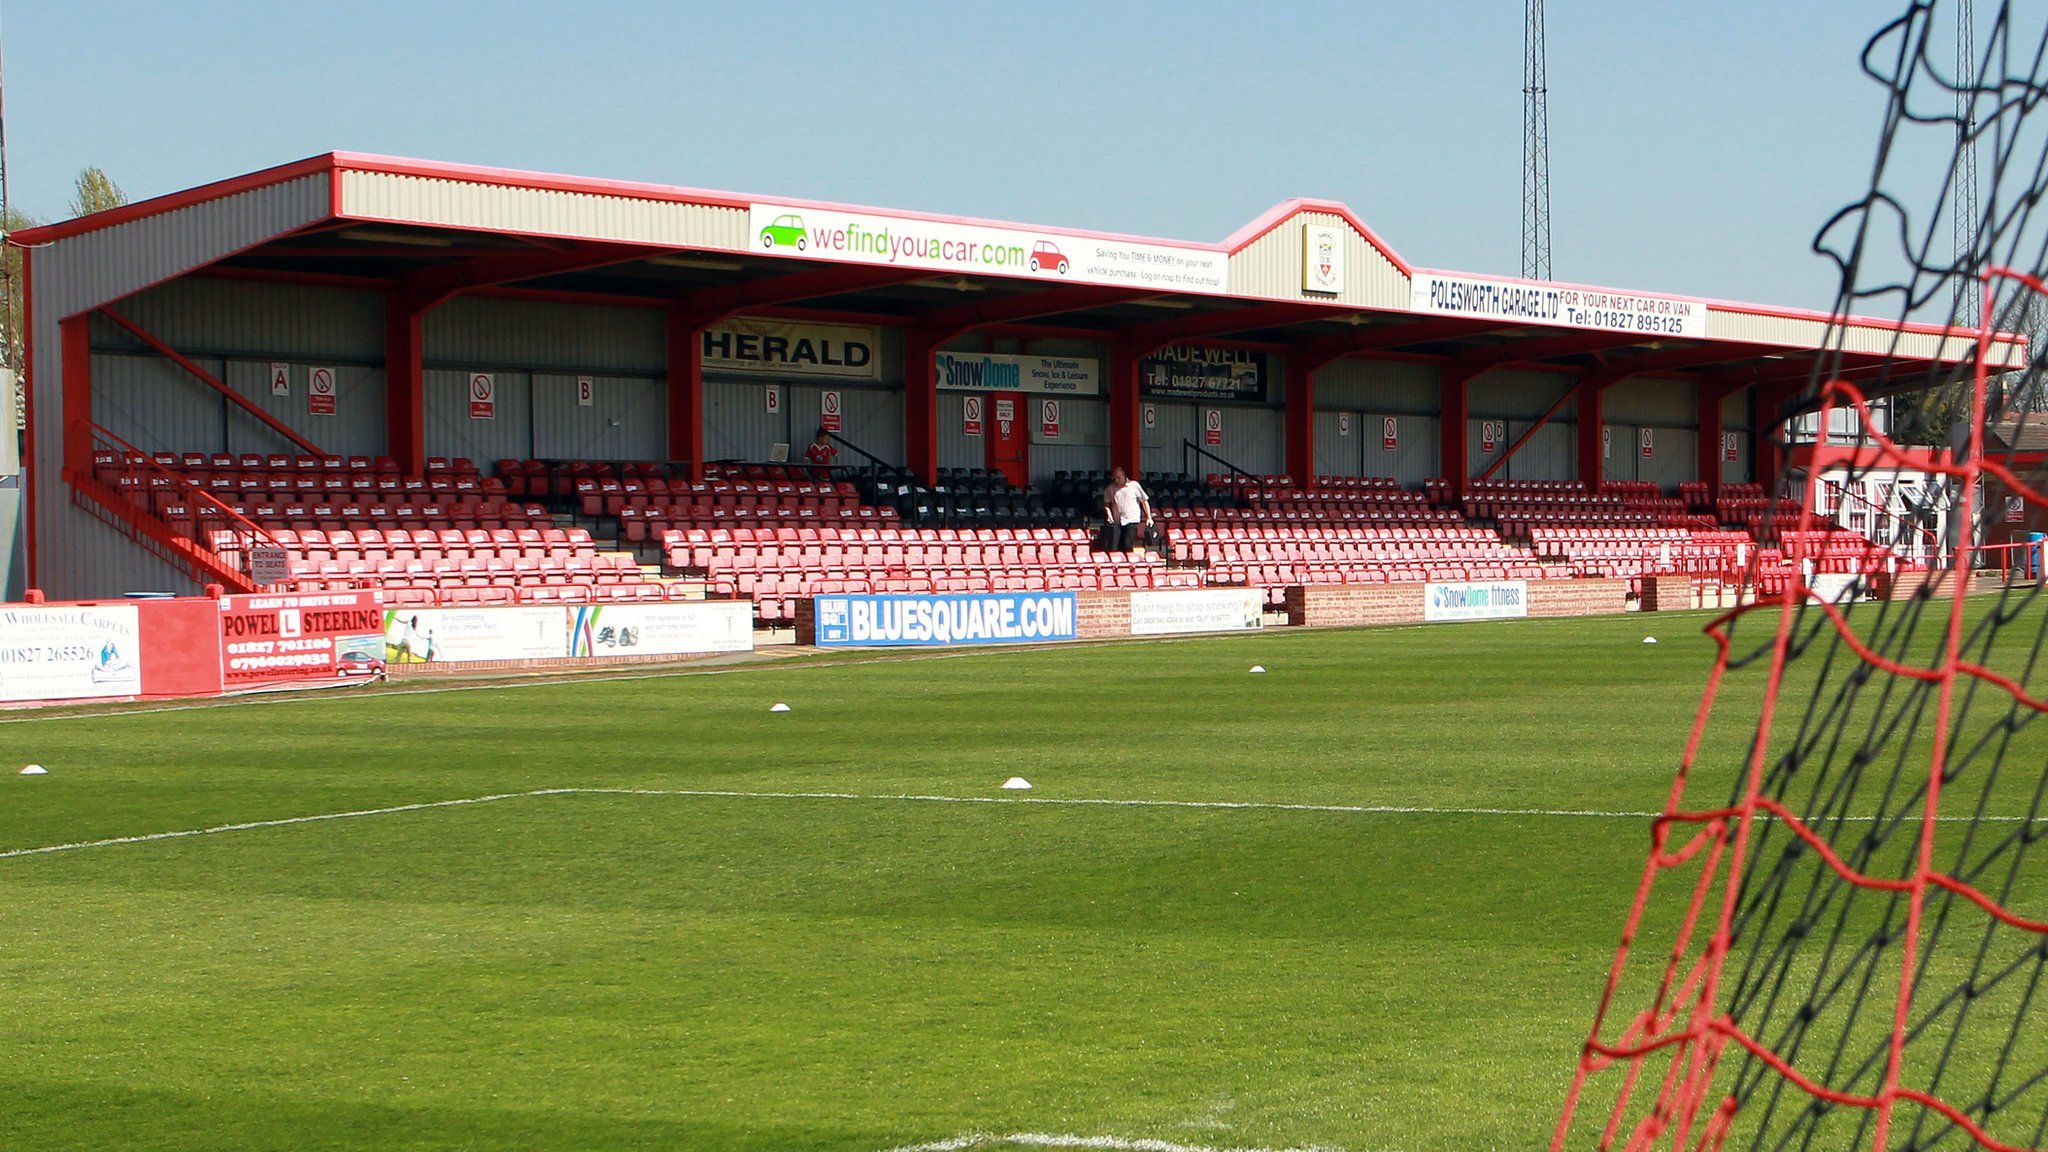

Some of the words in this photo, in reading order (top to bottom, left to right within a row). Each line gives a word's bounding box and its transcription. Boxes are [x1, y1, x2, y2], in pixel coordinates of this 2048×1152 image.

[813, 223, 1025, 267] wefindyouacar.com
[1096, 248, 1117, 261] Saving
[1131, 252, 1145, 262] TIME
[1153, 254, 1176, 265] MONEY
[1087, 265, 1108, 275] vehicle
[1110, 269, 1136, 279] purchase
[1141, 270, 1152, 281] Log
[1175, 274, 1182, 282] to
[1430, 279, 1499, 315] POLESWORTH
[1501, 286, 1539, 318] GARAGE
[1541, 290, 1559, 320] LTD
[1560, 291, 1579, 306] FOR
[1583, 293, 1608, 309] YOUR
[1609, 295, 1635, 311] NEXT
[1636, 298, 1656, 313] CAR
[1657, 300, 1671, 314] OR
[1672, 302, 1691, 316] VAN
[1567, 307, 1591, 325] Tel:
[1594, 309, 1633, 329] 01827
[1636, 314, 1683, 334] 895125
[703, 330, 871, 367] HERALD
[946, 354, 1020, 388] SnowDome
[1041, 359, 1052, 368] The
[1053, 360, 1079, 369] Ultimate
[274, 369, 288, 389] A
[1051, 371, 1060, 379] Ice
[1061, 371, 1067, 379] &
[1067, 371, 1088, 381] Leisure
[1147, 373, 1169, 386] Tel:
[1172, 375, 1206, 388] 01827
[1208, 377, 1241, 390] 67721
[581, 382, 590, 400] B
[1044, 380, 1077, 391] Experience
[768, 391, 777, 408] B
[1146, 409, 1154, 424] C
[1340, 418, 1348, 431] C
[253, 551, 287, 559] ENTRANCE
[254, 560, 263, 568] TO
[265, 560, 285, 568] SEATS
[248, 597, 283, 609] LEARN
[284, 596, 299, 608] TO
[299, 595, 330, 607] DRIVE
[330, 594, 357, 606] WITH
[1443, 585, 1489, 608] SnowDome
[1491, 584, 1520, 606] fitness
[1133, 603, 1153, 614] Want
[1157, 602, 1174, 614] help
[1176, 602, 1185, 612] to
[1187, 601, 1204, 613] stop
[1207, 599, 1243, 613] smoking?
[80, 611, 130, 636] CARPETS
[304, 609, 379, 633] STEERING
[851, 597, 1073, 644] BLUESQUARE.COM
[1, 647, 42, 664] 01827
[47, 645, 94, 662] 265526
[227, 640, 275, 655] 01827
[276, 636, 332, 653] 701106
